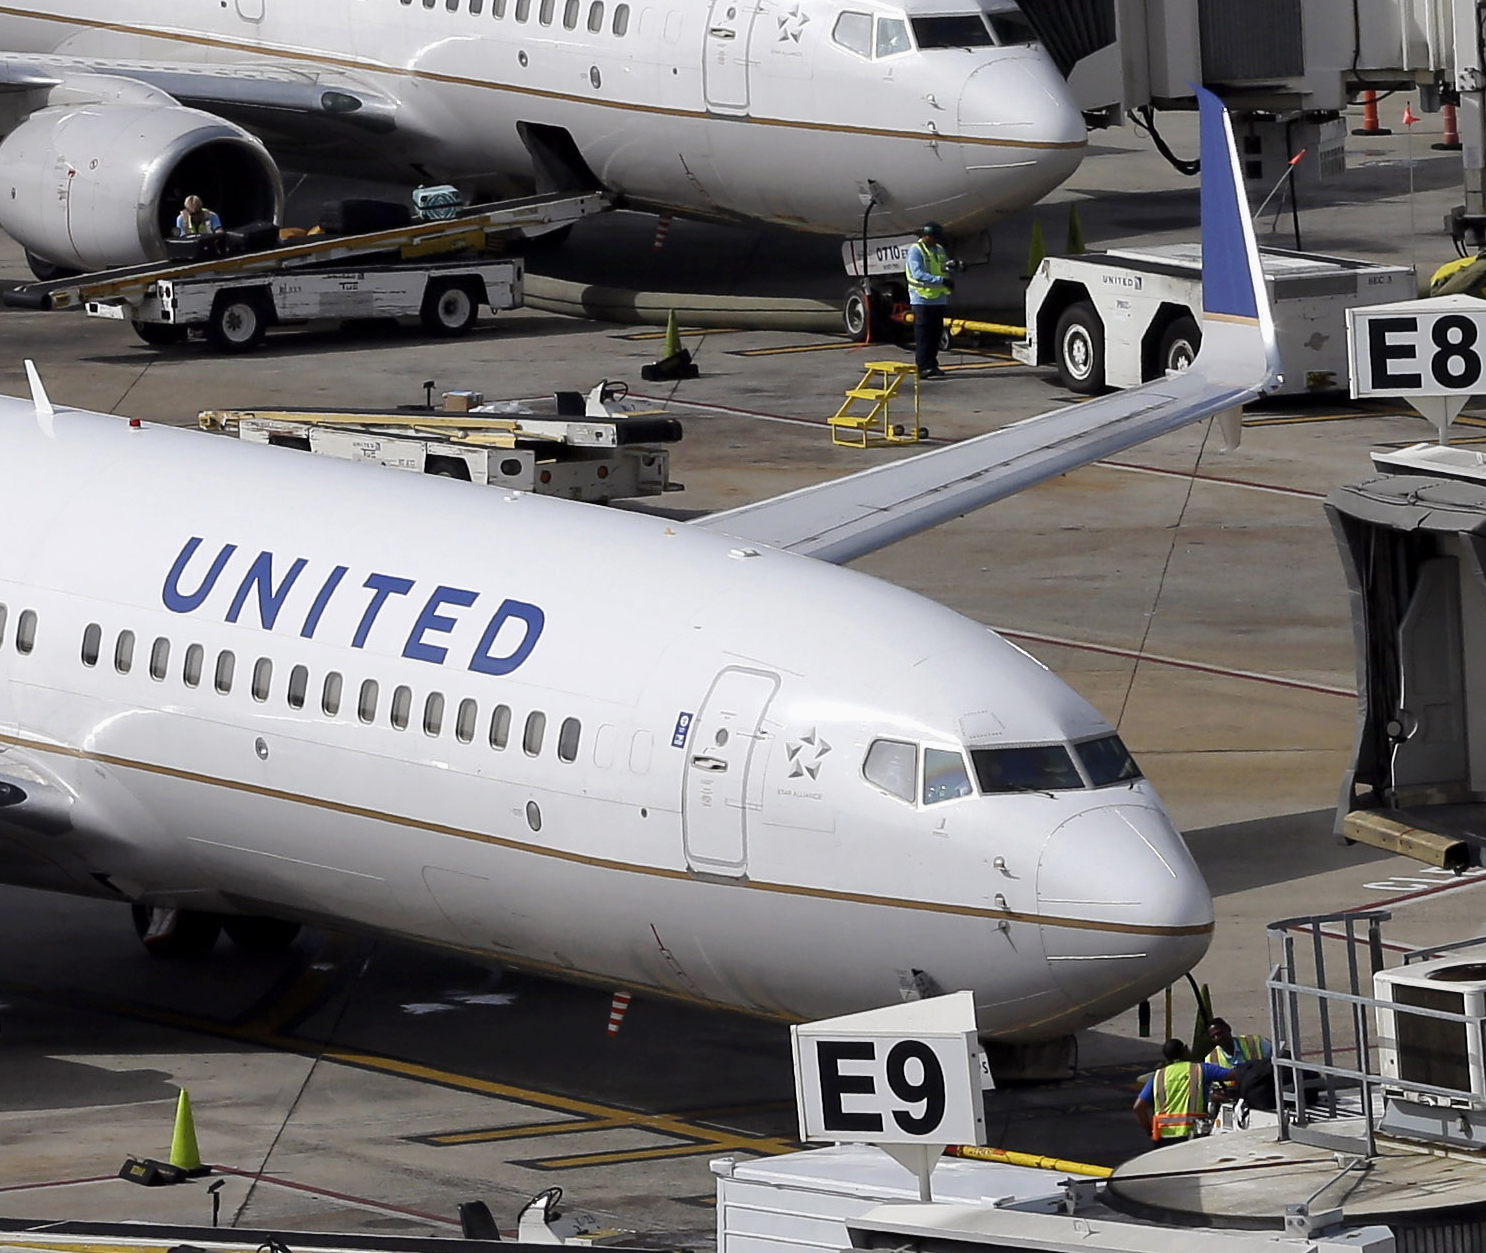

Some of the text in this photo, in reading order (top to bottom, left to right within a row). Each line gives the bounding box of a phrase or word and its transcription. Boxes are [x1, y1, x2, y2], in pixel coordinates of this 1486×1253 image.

[876, 245, 900, 262] 0710
[1102, 275, 1134, 287] UNITED
[1368, 314, 1482, 391] E8
[161, 536, 545, 676] UNITED
[817, 1040, 947, 1136] E9
